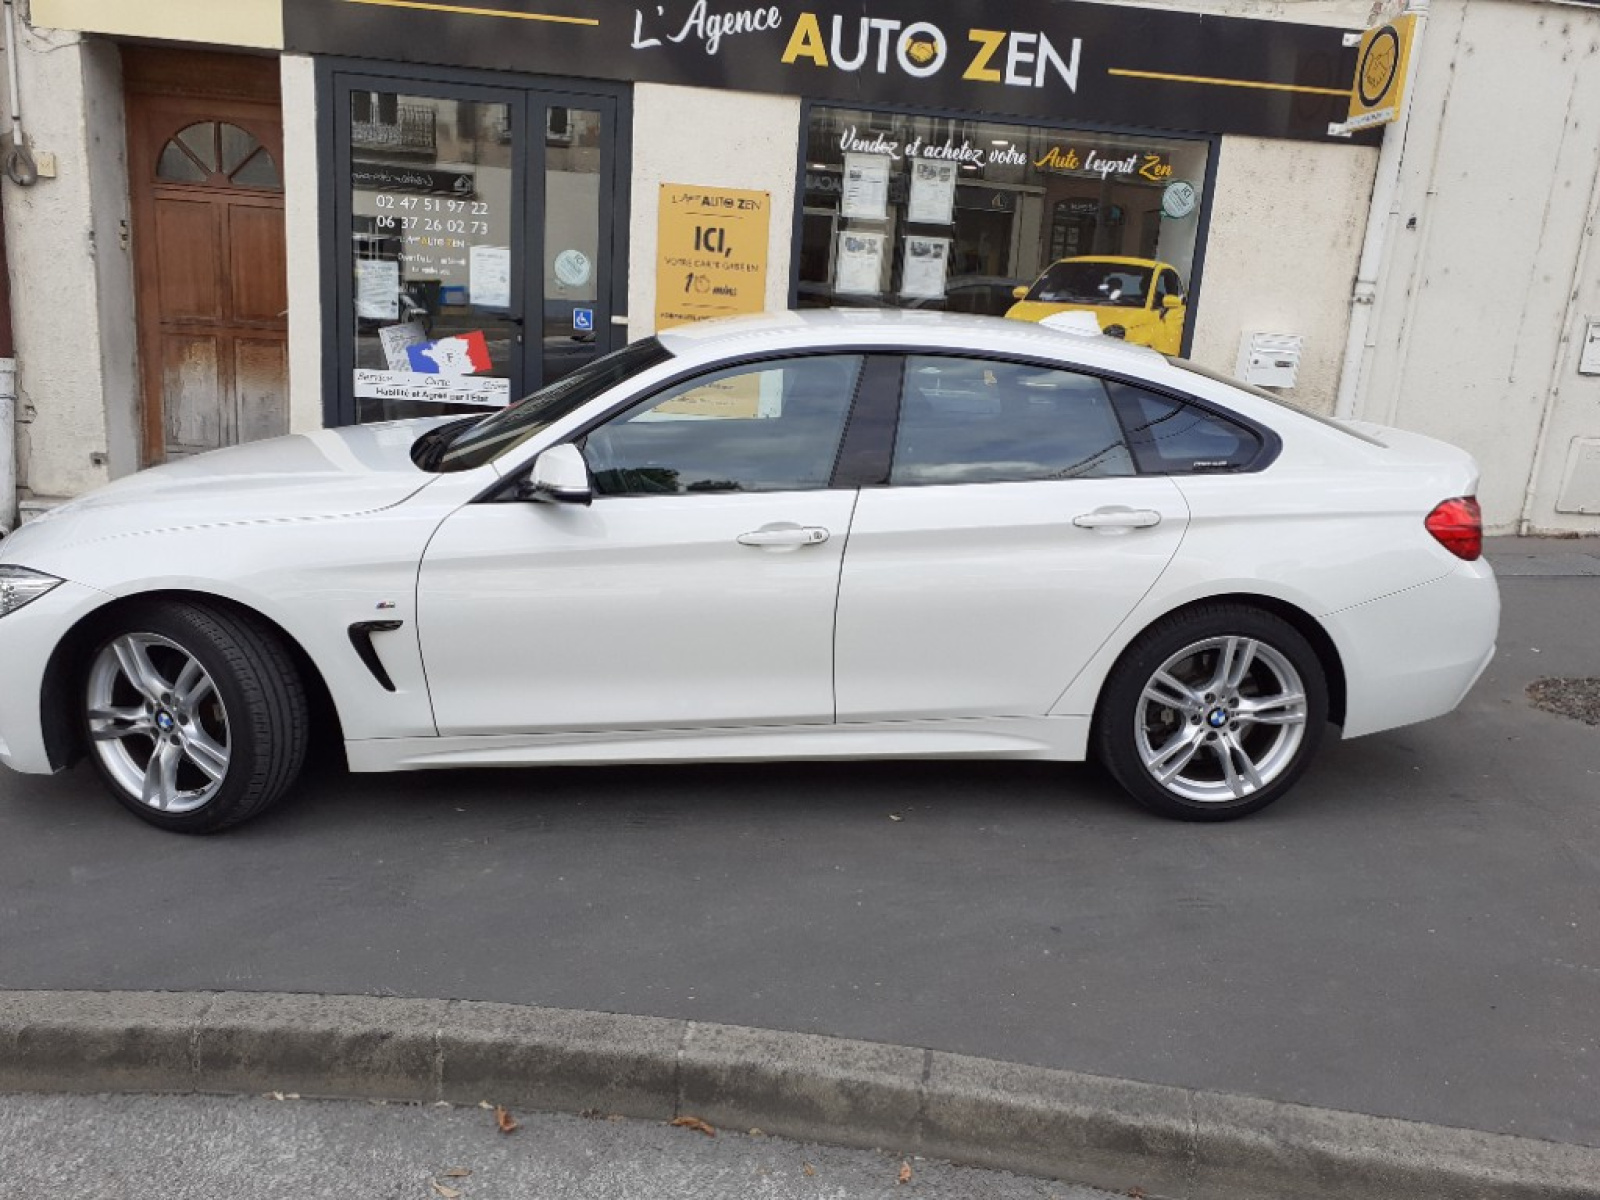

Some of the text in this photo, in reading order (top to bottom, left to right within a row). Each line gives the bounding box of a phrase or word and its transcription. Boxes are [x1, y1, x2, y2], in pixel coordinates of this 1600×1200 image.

[781, 12, 948, 78] AUTO
[962, 29, 1082, 94] ZEN
[840, 125, 900, 160] Vendez
[905, 136, 922, 156] et
[924, 139, 986, 167] achetez
[989, 144, 1026, 165] votre
[1033, 146, 1080, 169] Auto
[1138, 154, 1173, 180] Zen
[376, 195, 488, 215] 02 47 51 97 22
[737, 198, 762, 212] ZEN
[376, 215, 488, 235] 06 37 26 02 73
[694, 226, 732, 258] ICI,
